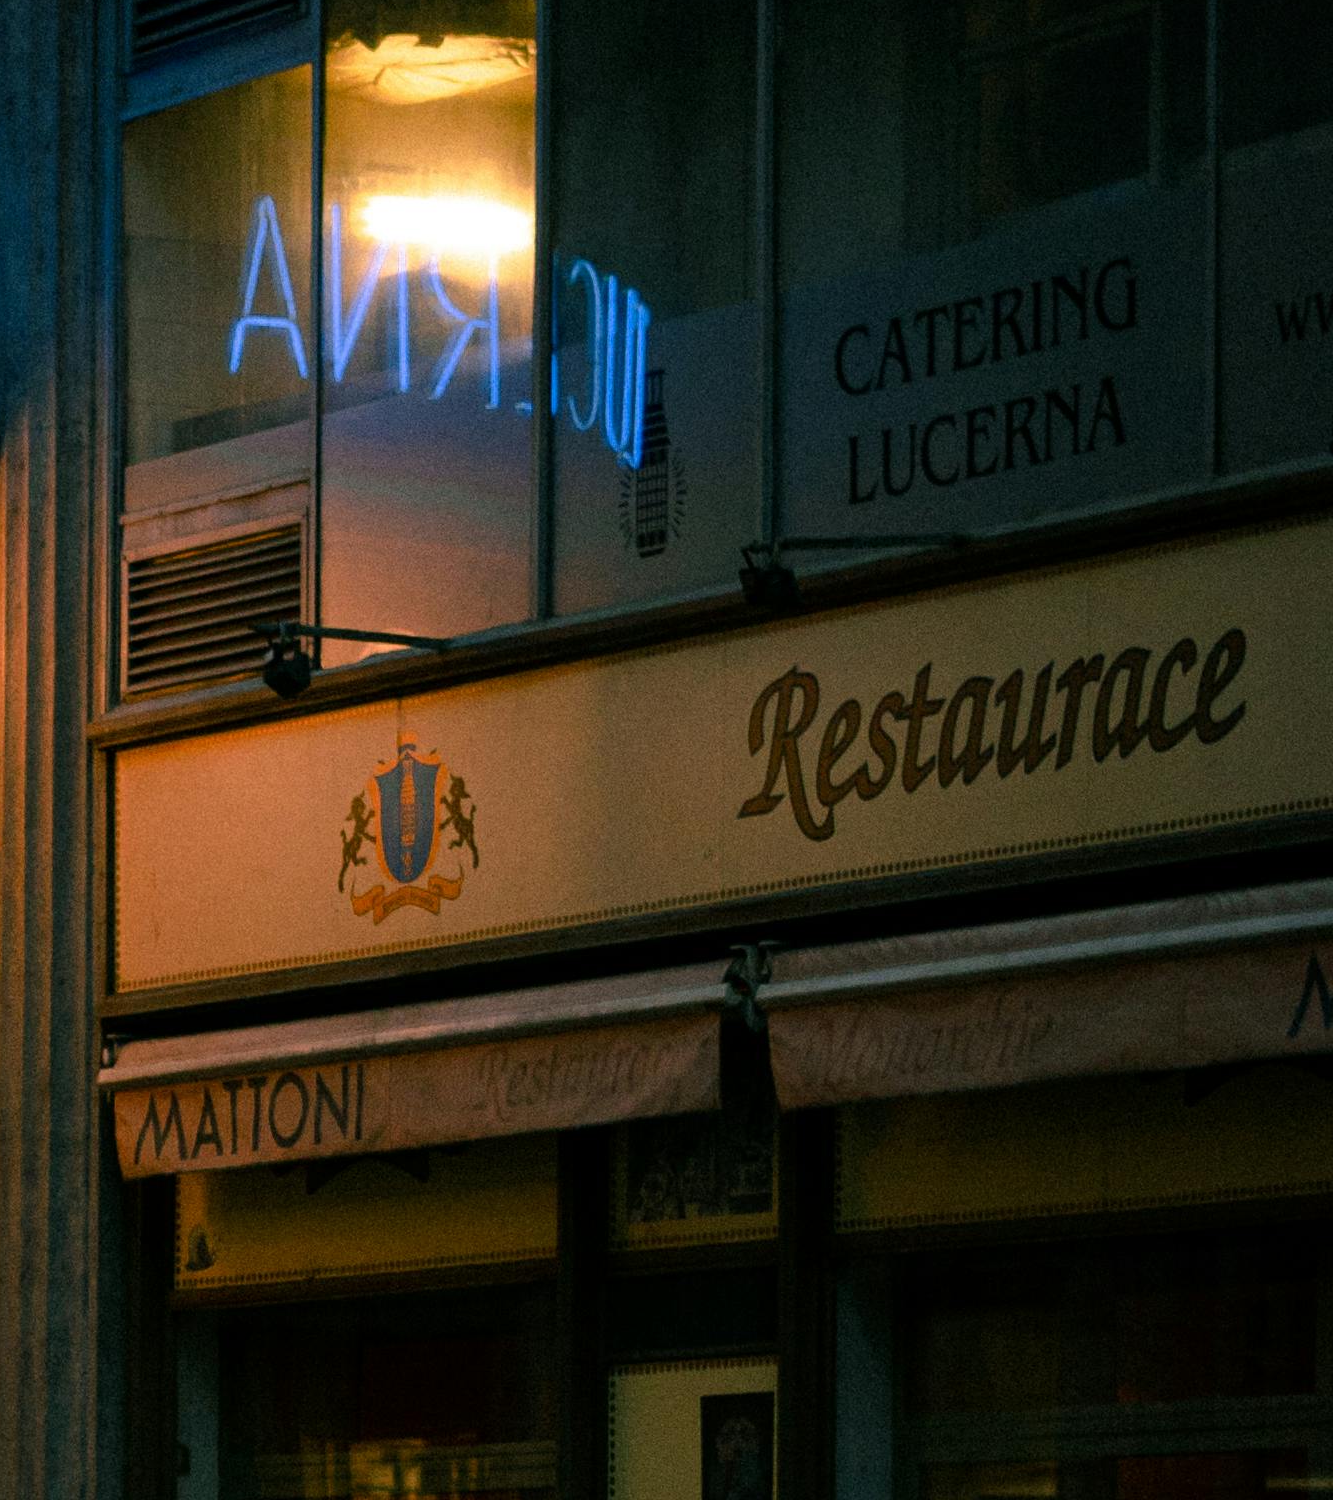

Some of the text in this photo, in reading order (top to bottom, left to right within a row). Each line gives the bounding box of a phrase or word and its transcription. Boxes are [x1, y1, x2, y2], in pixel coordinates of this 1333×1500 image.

[835, 258, 1137, 396] CATERING
[847, 375, 1127, 505] LUCERNA
[737, 627, 1247, 842] Restaurace
[134, 1062, 367, 1165] MATTONI
